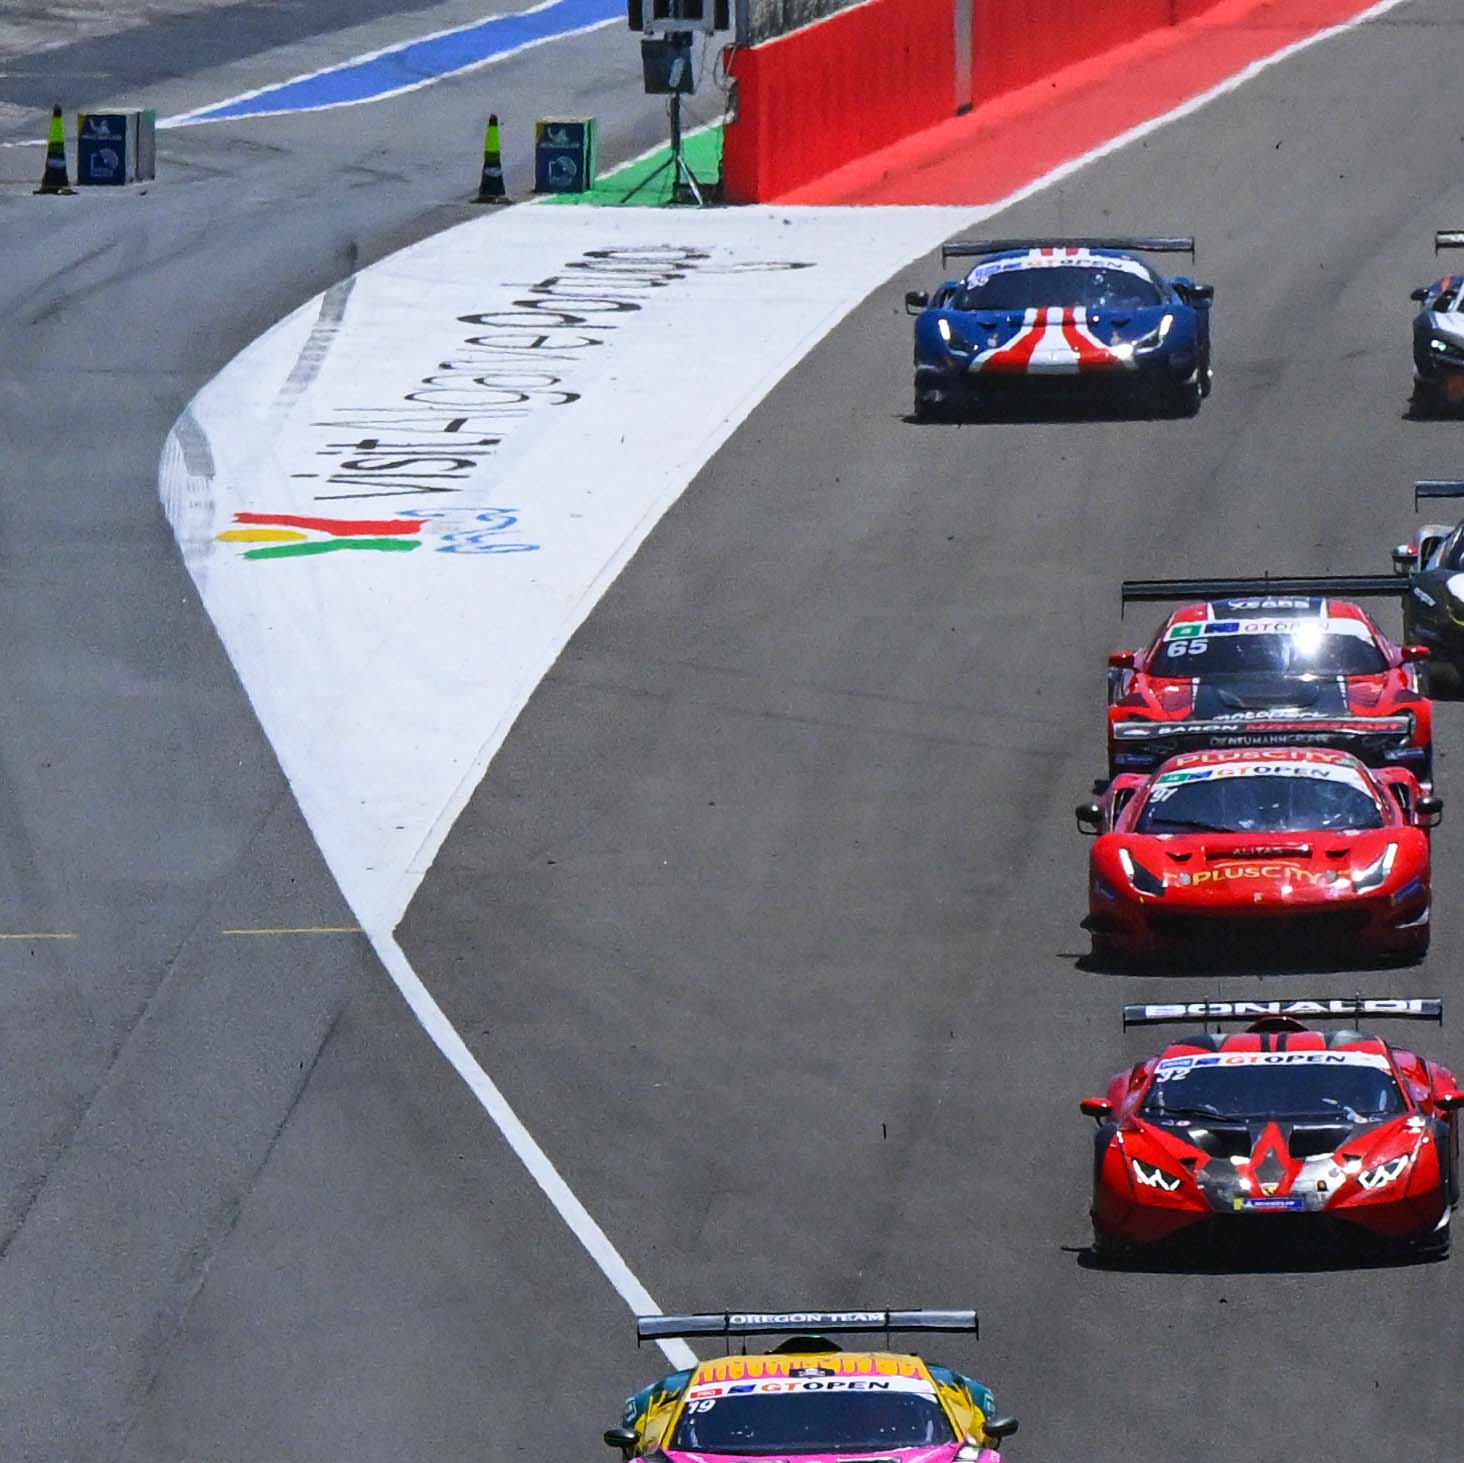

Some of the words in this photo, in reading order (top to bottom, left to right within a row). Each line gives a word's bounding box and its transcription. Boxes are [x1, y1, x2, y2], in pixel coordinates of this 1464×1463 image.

[1167, 639, 1208, 657] 65
[1158, 724, 1239, 735] BARON
[1217, 765, 1331, 778] GTOPEN
[1145, 1000, 1423, 1018] BONALDI
[1225, 1055, 1346, 1066] GTOPEN
[729, 1314, 822, 1325] OREGON
[828, 1312, 886, 1323] TEAM
[761, 1381, 890, 1392] GTOPEN
[687, 1399, 716, 1415] 19
